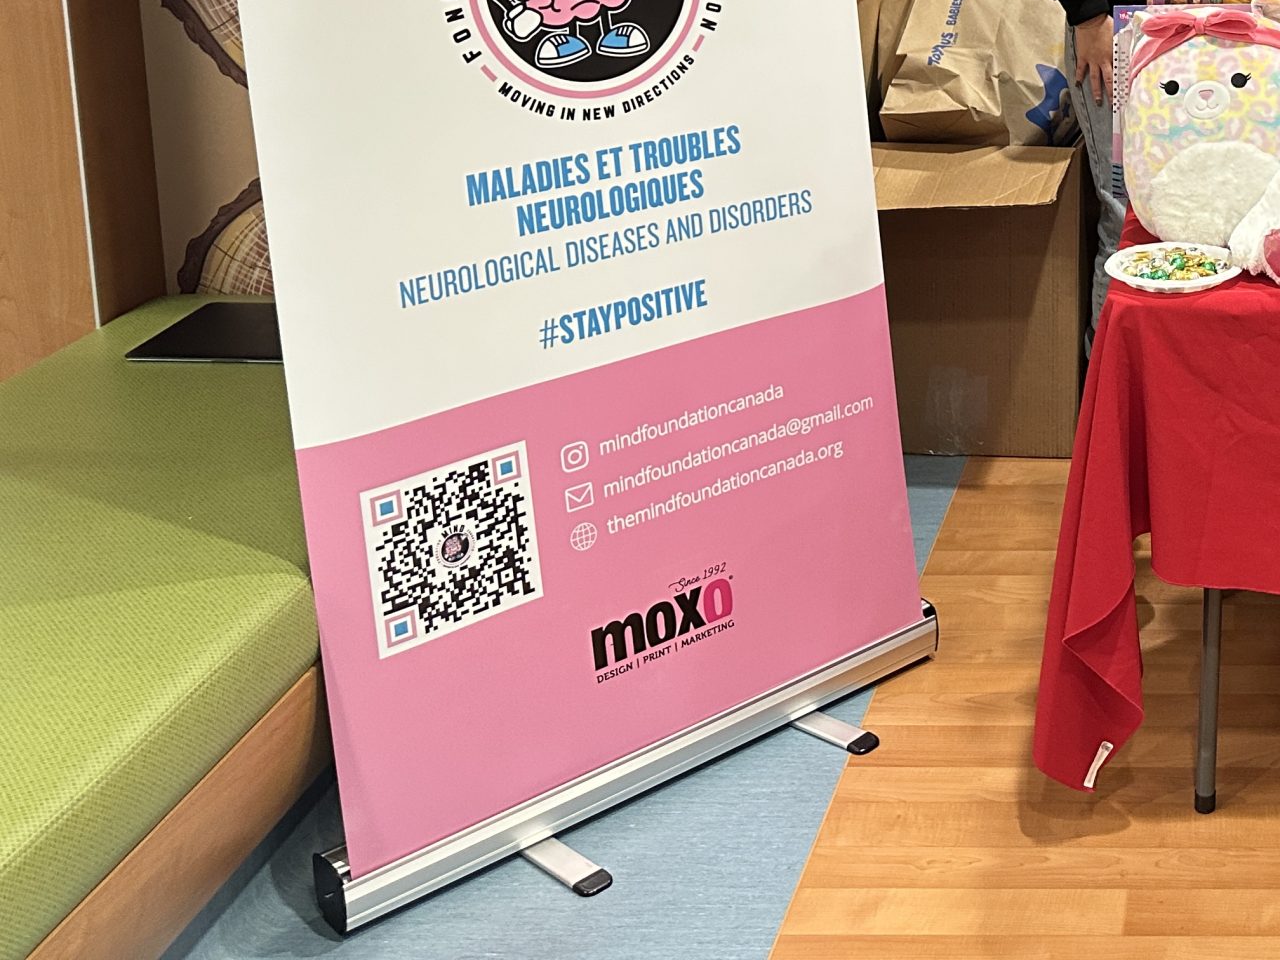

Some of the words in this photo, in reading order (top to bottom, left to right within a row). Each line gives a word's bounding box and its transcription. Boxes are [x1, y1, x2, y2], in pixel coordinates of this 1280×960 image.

[497, 80, 557, 119] MOVING
[560, 105, 577, 122] IN
[582, 104, 617, 122] NEW
[622, 53, 697, 115] DIRECTIONS
[465, 153, 591, 207] MALADIES
[595, 147, 623, 180] ET
[628, 125, 743, 174] TROUBLES
[516, 170, 706, 237] NEUROLOGIQUES
[398, 243, 562, 310] NEUROLOGICAL
[565, 221, 662, 271] DISEASES
[665, 214, 705, 243] AND
[709, 189, 814, 236] DISORDERS
[538, 279, 709, 351] #STAYPOSITIVE
[597, 382, 785, 458] mindfoundationcanada
[602, 394, 876, 500] mindfoundationcanada@gmail.com
[605, 439, 846, 538] themindfoundationcanada.org
[668, 575, 701, 594] Since
[701, 561, 727, 584] 1992
[595, 661, 636, 685] DESIGN
[641, 648, 673, 668] PRINT
[679, 618, 736, 650] MARKETING
